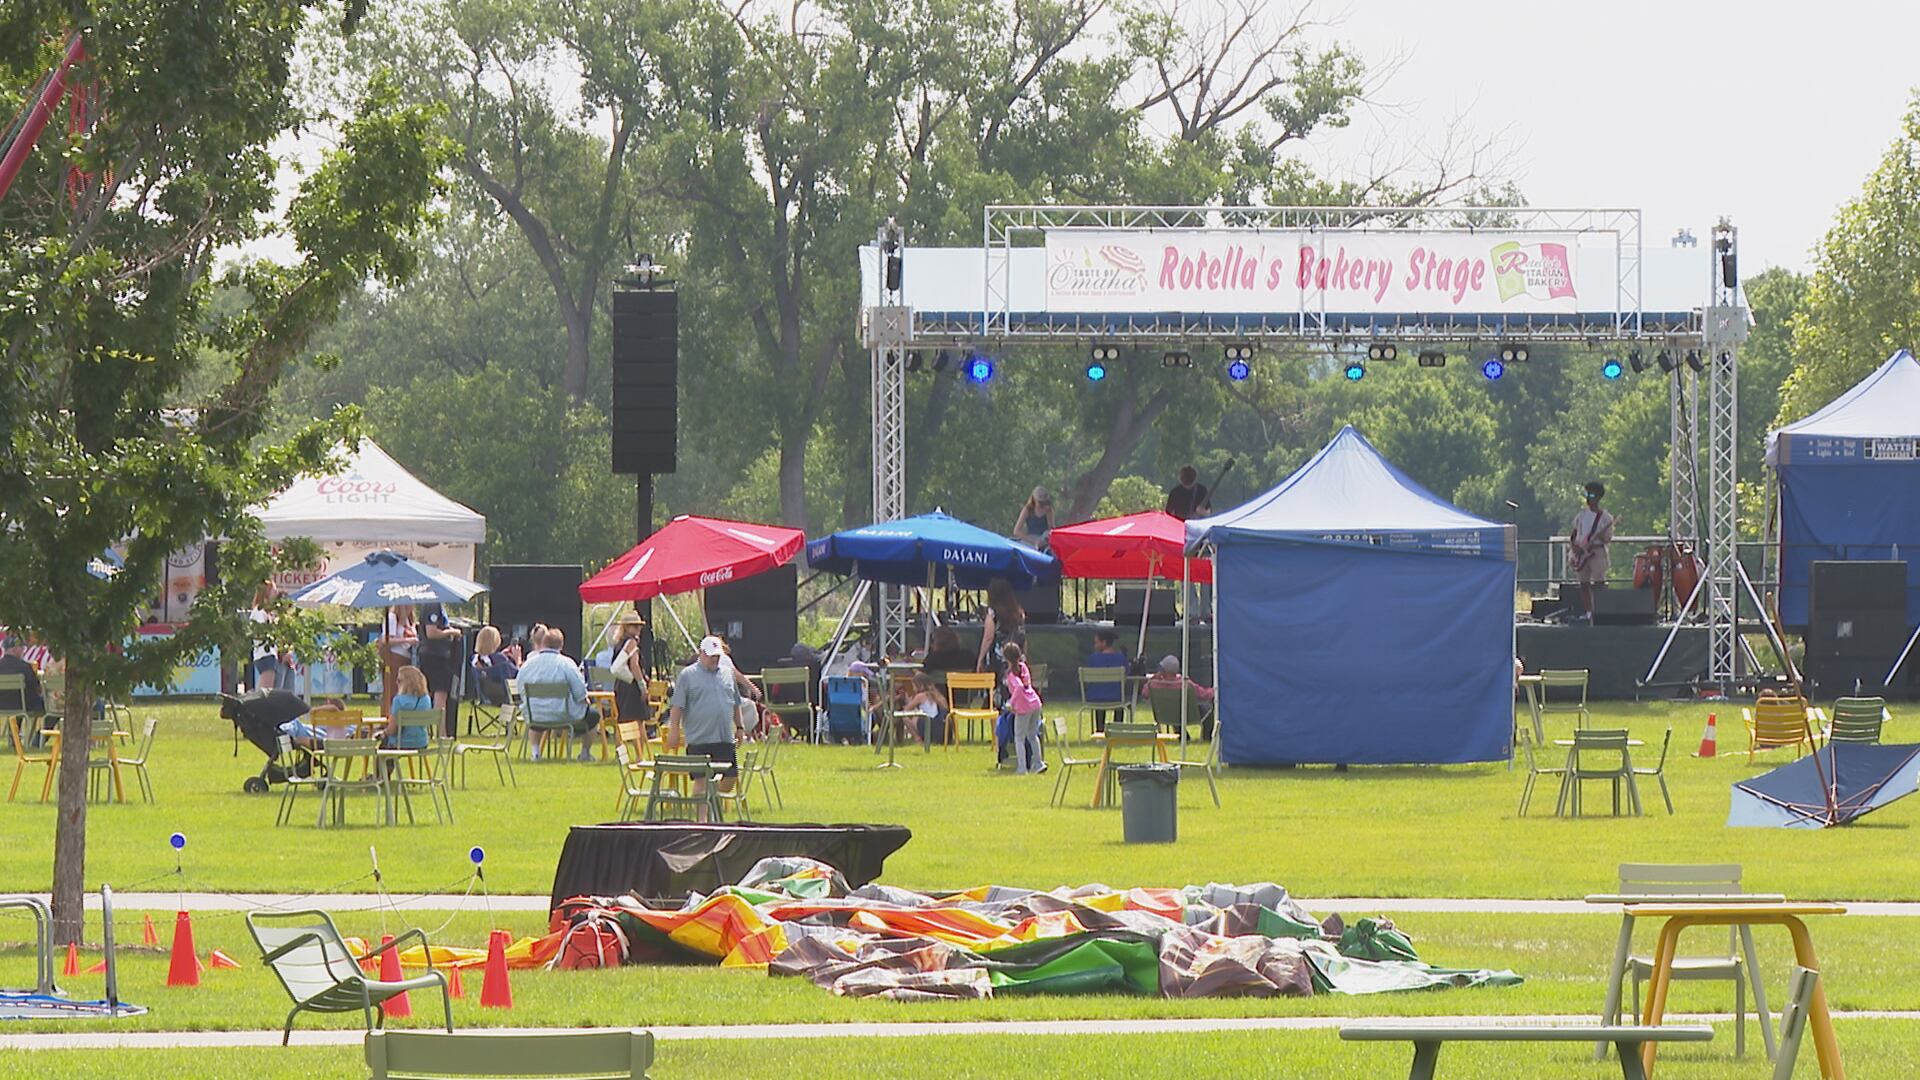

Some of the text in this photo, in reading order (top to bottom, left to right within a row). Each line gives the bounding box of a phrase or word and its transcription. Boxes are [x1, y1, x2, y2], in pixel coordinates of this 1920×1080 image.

[1049, 261, 1136, 290] Omaha
[1159, 245, 1484, 304] Rotella's Bakery Stage
[1526, 269, 1564, 278] ITALIAN
[1527, 279, 1567, 287] BAKERY
[1877, 443, 1911, 451] WATTS
[317, 477, 397, 494] Coors
[326, 494, 390, 504] LIGHT
[943, 548, 988, 564] DASANI
